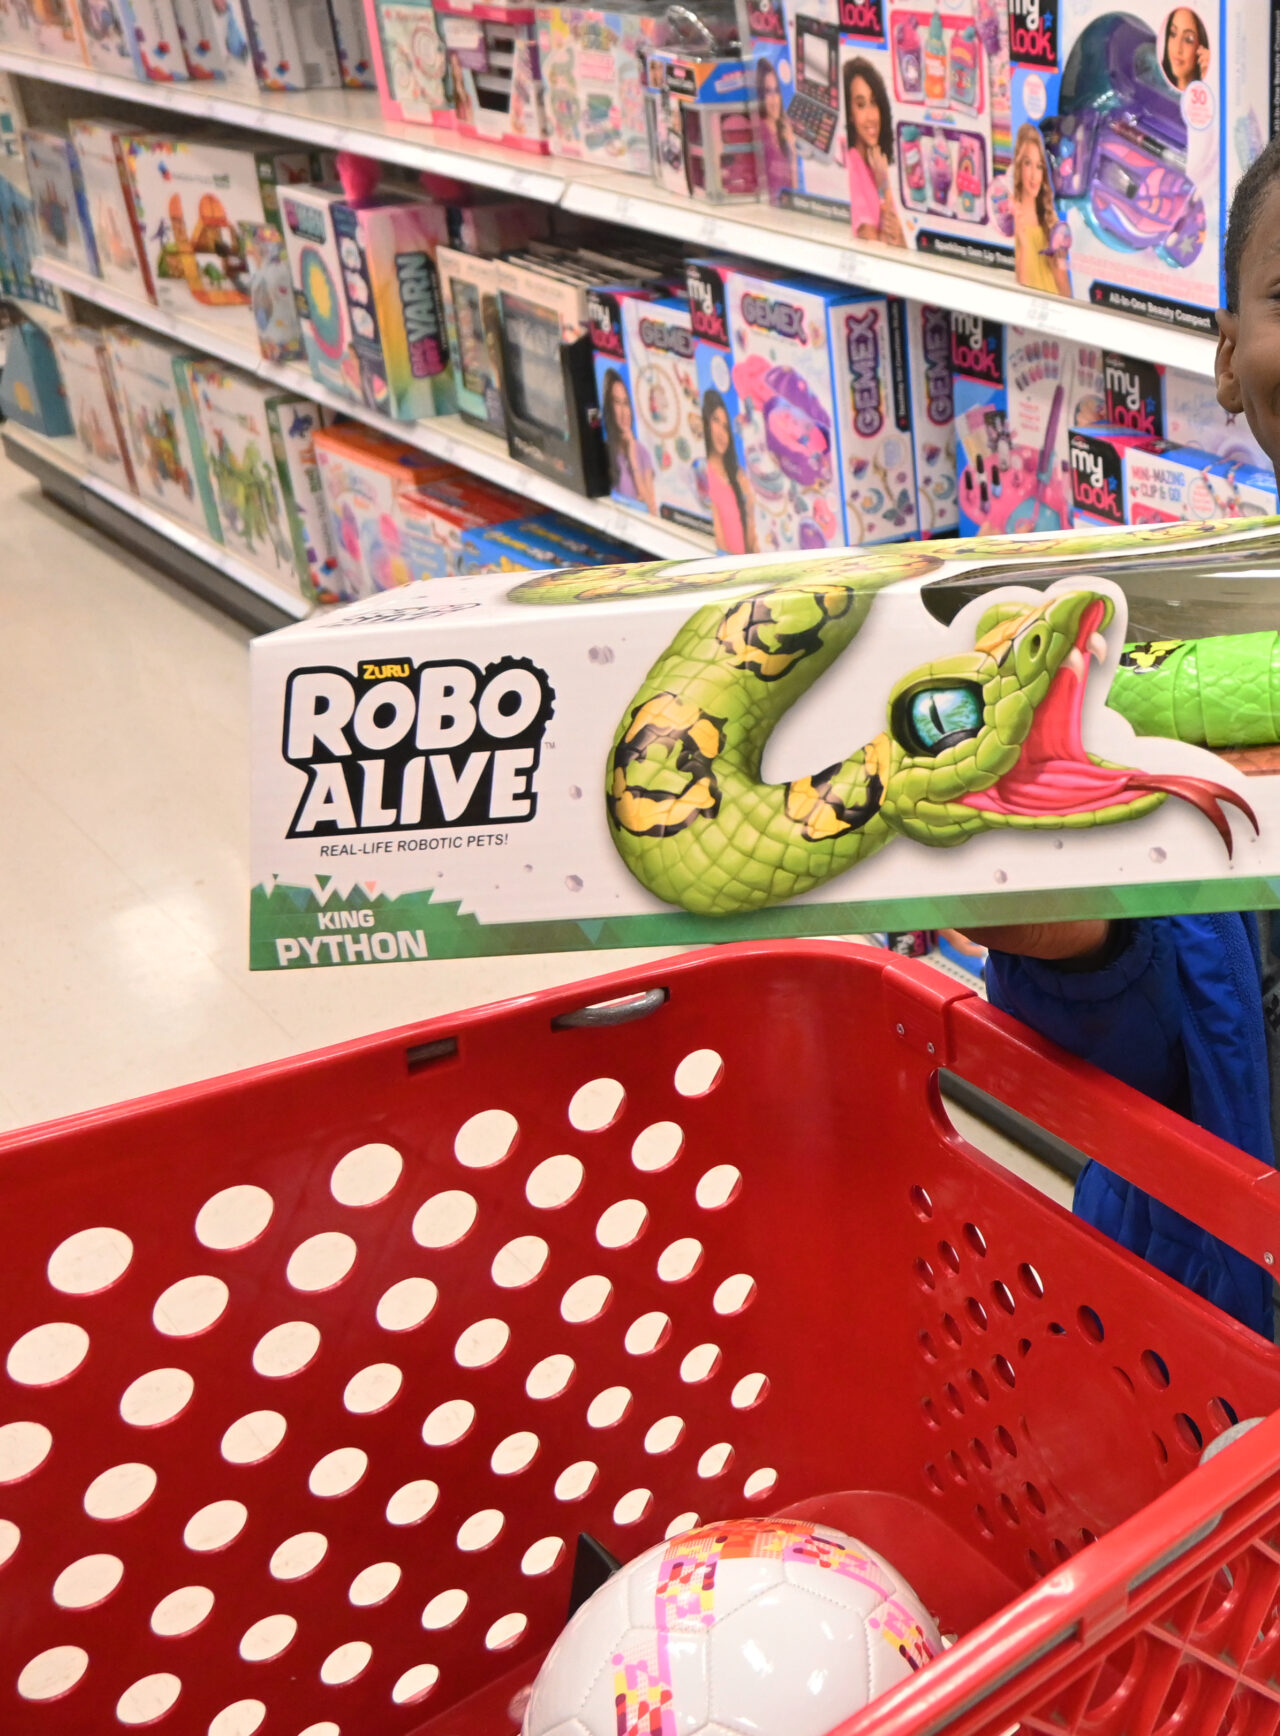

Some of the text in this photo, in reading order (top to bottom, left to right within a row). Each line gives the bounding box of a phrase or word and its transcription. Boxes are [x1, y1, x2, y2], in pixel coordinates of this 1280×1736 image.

[841, 0, 881, 31] look
[1010, 13, 1056, 60] look
[1191, 88, 1207, 105] 30
[396, 253, 437, 343] YARN
[687, 277, 713, 314] my
[740, 293, 807, 346] GEMEX
[951, 310, 983, 349] my
[844, 307, 884, 438] GEMEX
[952, 331, 1000, 378] look
[1105, 367, 1140, 411] my
[1107, 388, 1156, 437] look
[1071, 447, 1103, 488] my
[1074, 468, 1121, 517] look
[363, 664, 410, 680] ZURU
[287, 665, 542, 760] ROBO
[295, 748, 539, 832] ALIVE
[320, 832, 509, 858] REAL-LIFE ROBOTIC PETS!
[317, 908, 375, 930] KING
[275, 930, 428, 967] PYTHON
